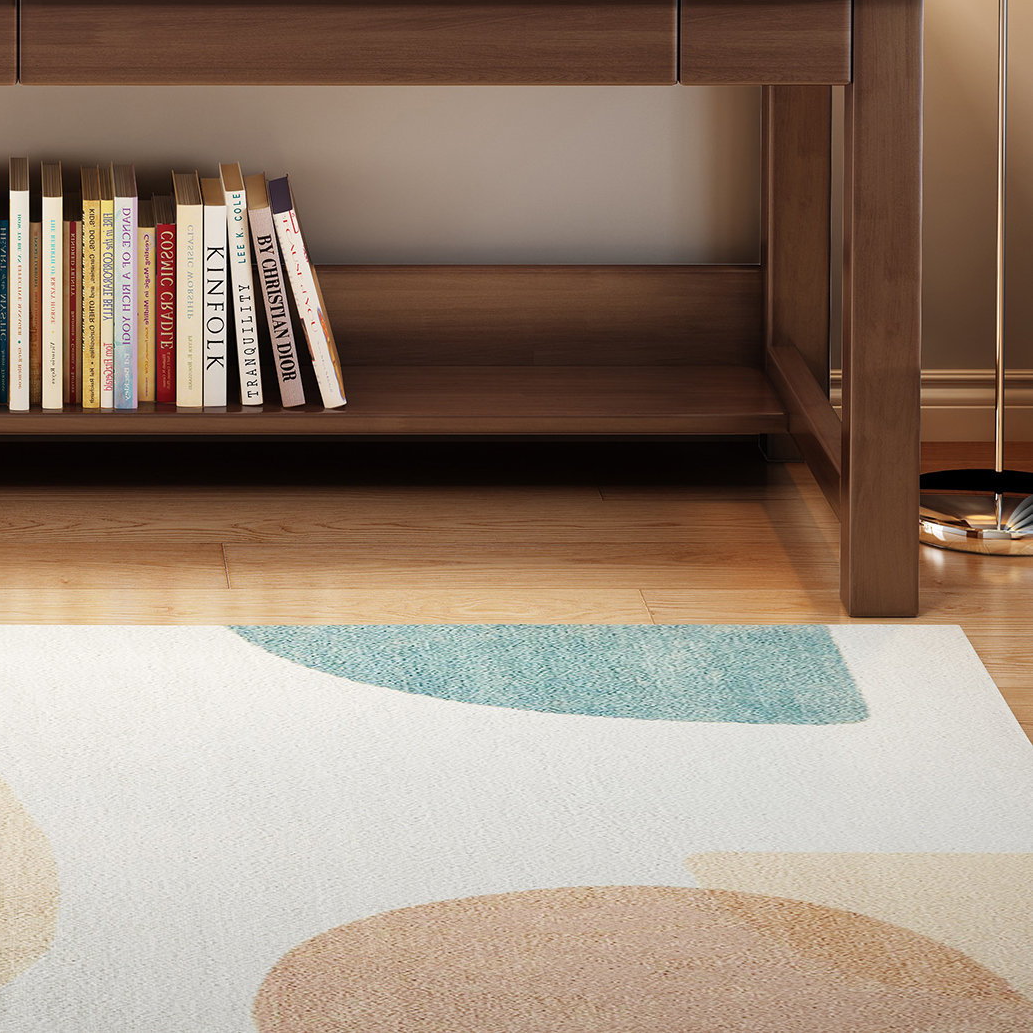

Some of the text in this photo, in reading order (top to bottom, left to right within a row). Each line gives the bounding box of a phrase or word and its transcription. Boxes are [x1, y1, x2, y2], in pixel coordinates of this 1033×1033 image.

[232, 193, 246, 264] LEE K. COLE
[207, 247, 225, 370] KINFOLK
[239, 284, 260, 398] TRANQUILITY
[257, 234, 297, 382] BY CHRISTIAN DIOR
